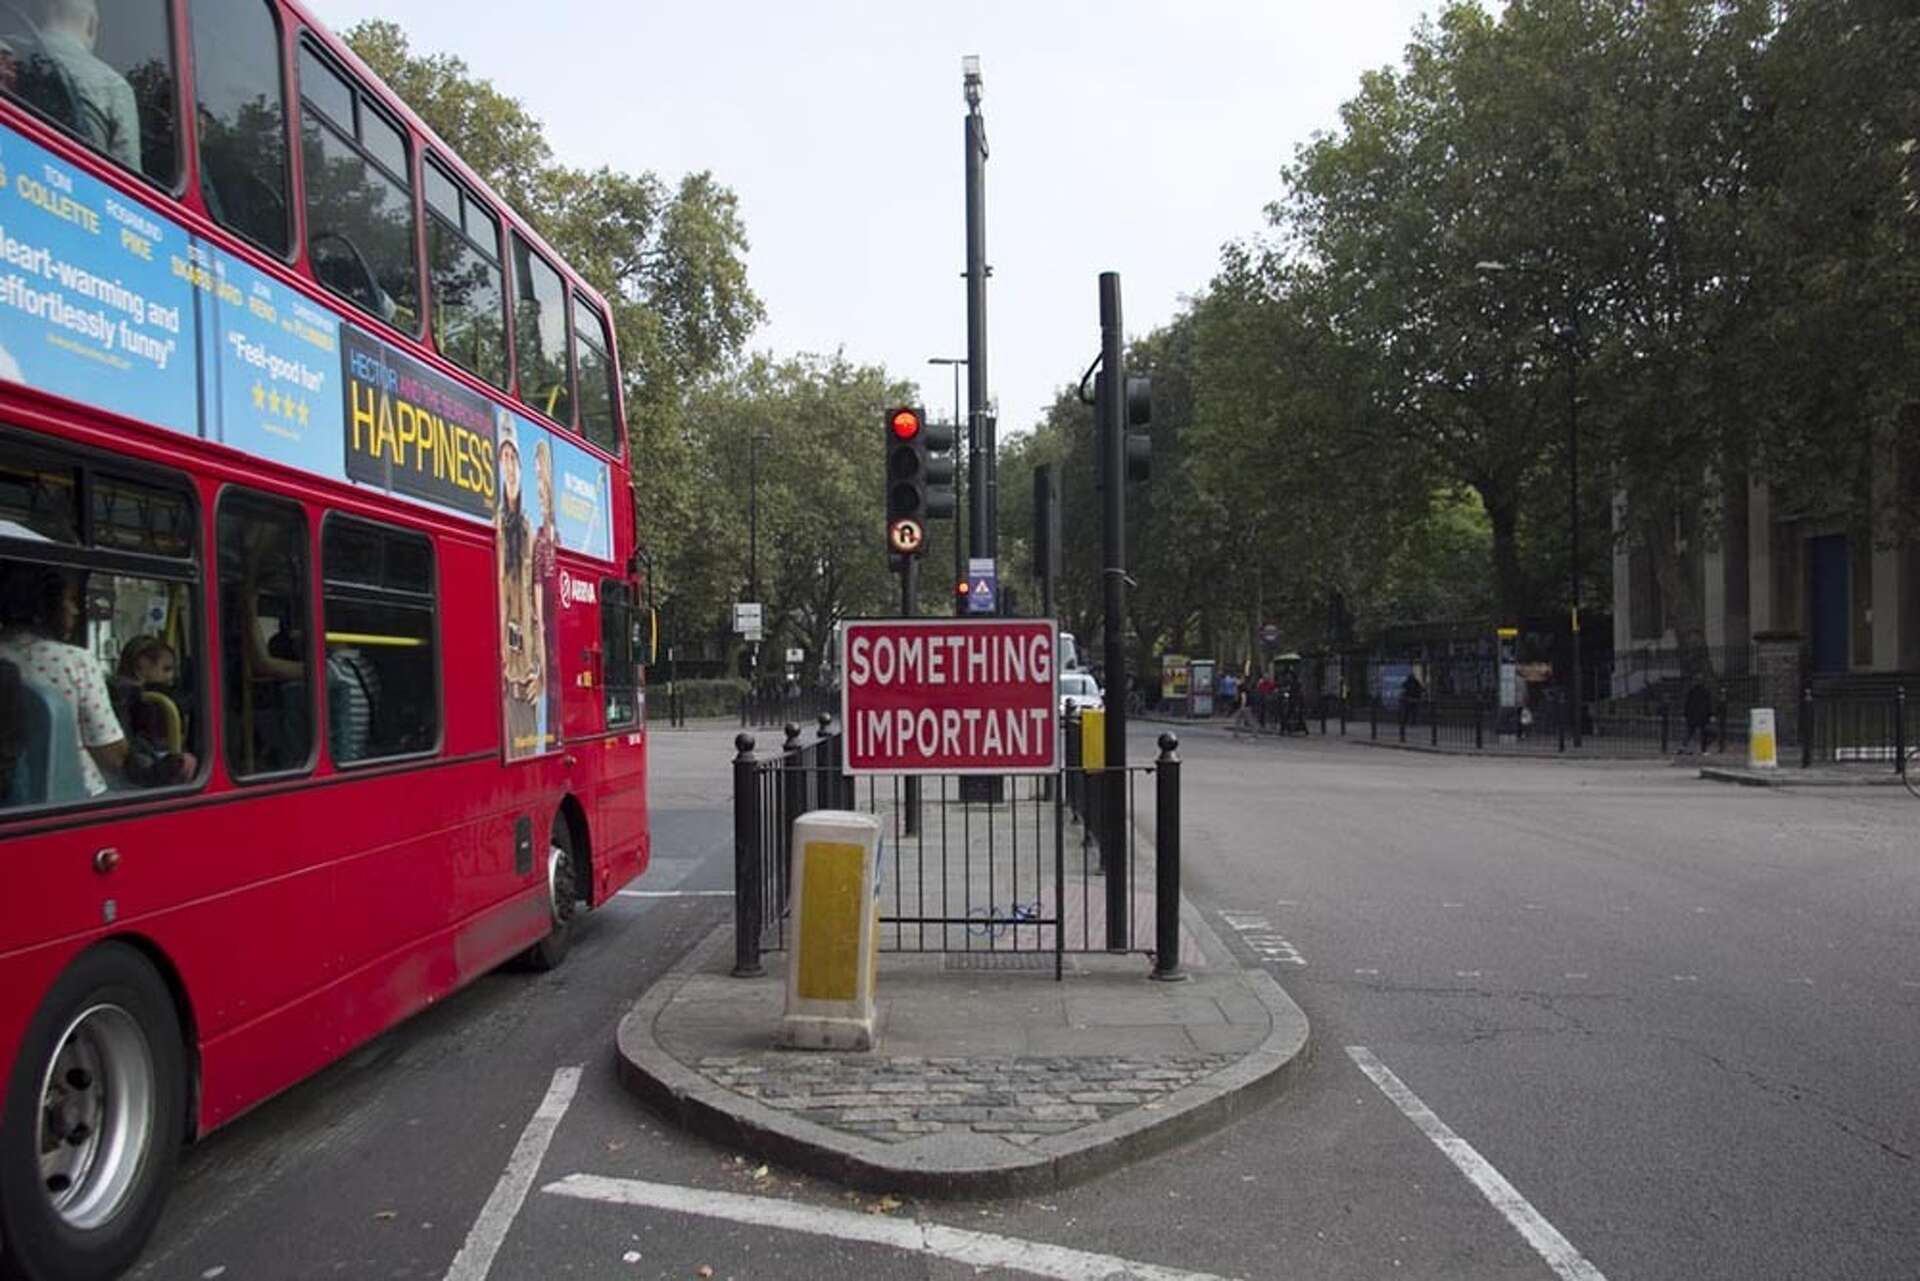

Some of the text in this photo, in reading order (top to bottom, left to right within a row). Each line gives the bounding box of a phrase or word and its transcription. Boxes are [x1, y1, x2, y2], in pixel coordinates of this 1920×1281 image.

[16, 174, 101, 235] COLLETTE
[148, 301, 180, 333] and
[352, 380, 495, 497] HAPPINESS
[850, 634, 1050, 685] SOMETHING
[857, 708, 1048, 757] IMPORTANT
